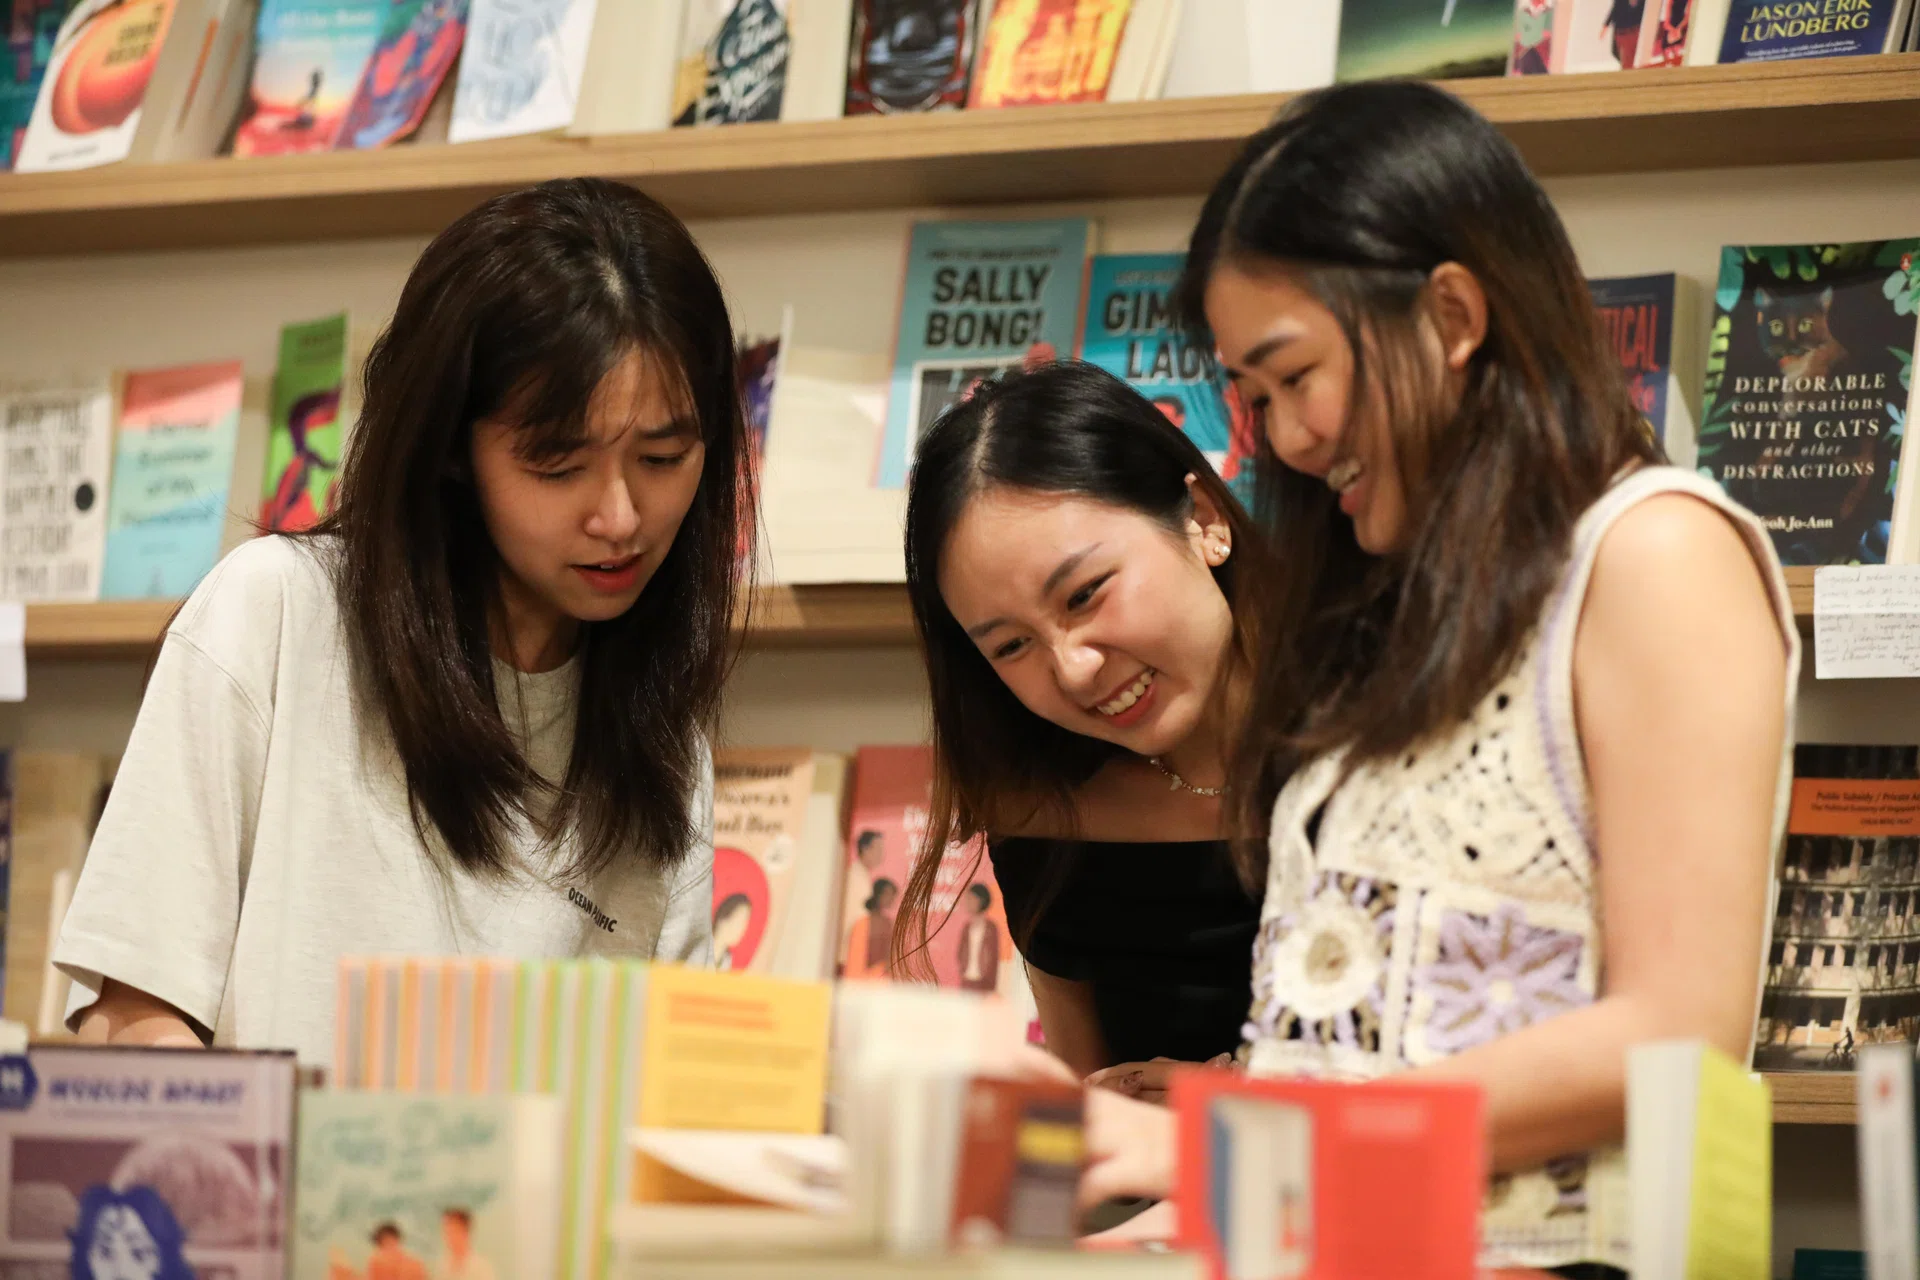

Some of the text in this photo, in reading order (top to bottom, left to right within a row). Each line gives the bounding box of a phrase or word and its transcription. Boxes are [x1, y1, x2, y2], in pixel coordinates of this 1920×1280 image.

[1747, 0, 1819, 23] JASON
[1740, 11, 1870, 43] LUNDBERG
[933, 265, 1049, 304] SALLY
[1104, 289, 1182, 332] GIM
[926, 309, 1043, 347] BONG!
[1126, 339, 1213, 381] LAO
[1734, 373, 1886, 394] DEPLORABLE
[1731, 395, 1883, 414] conversations
[1730, 418, 1880, 440] WITH CATS
[1763, 442, 1842, 457] and other
[1723, 461, 1875, 480] DISTRACTIONS
[1785, 515, 1834, 532] Jo-Ann
[568, 887, 618, 933] OCEAN PAIFIC
